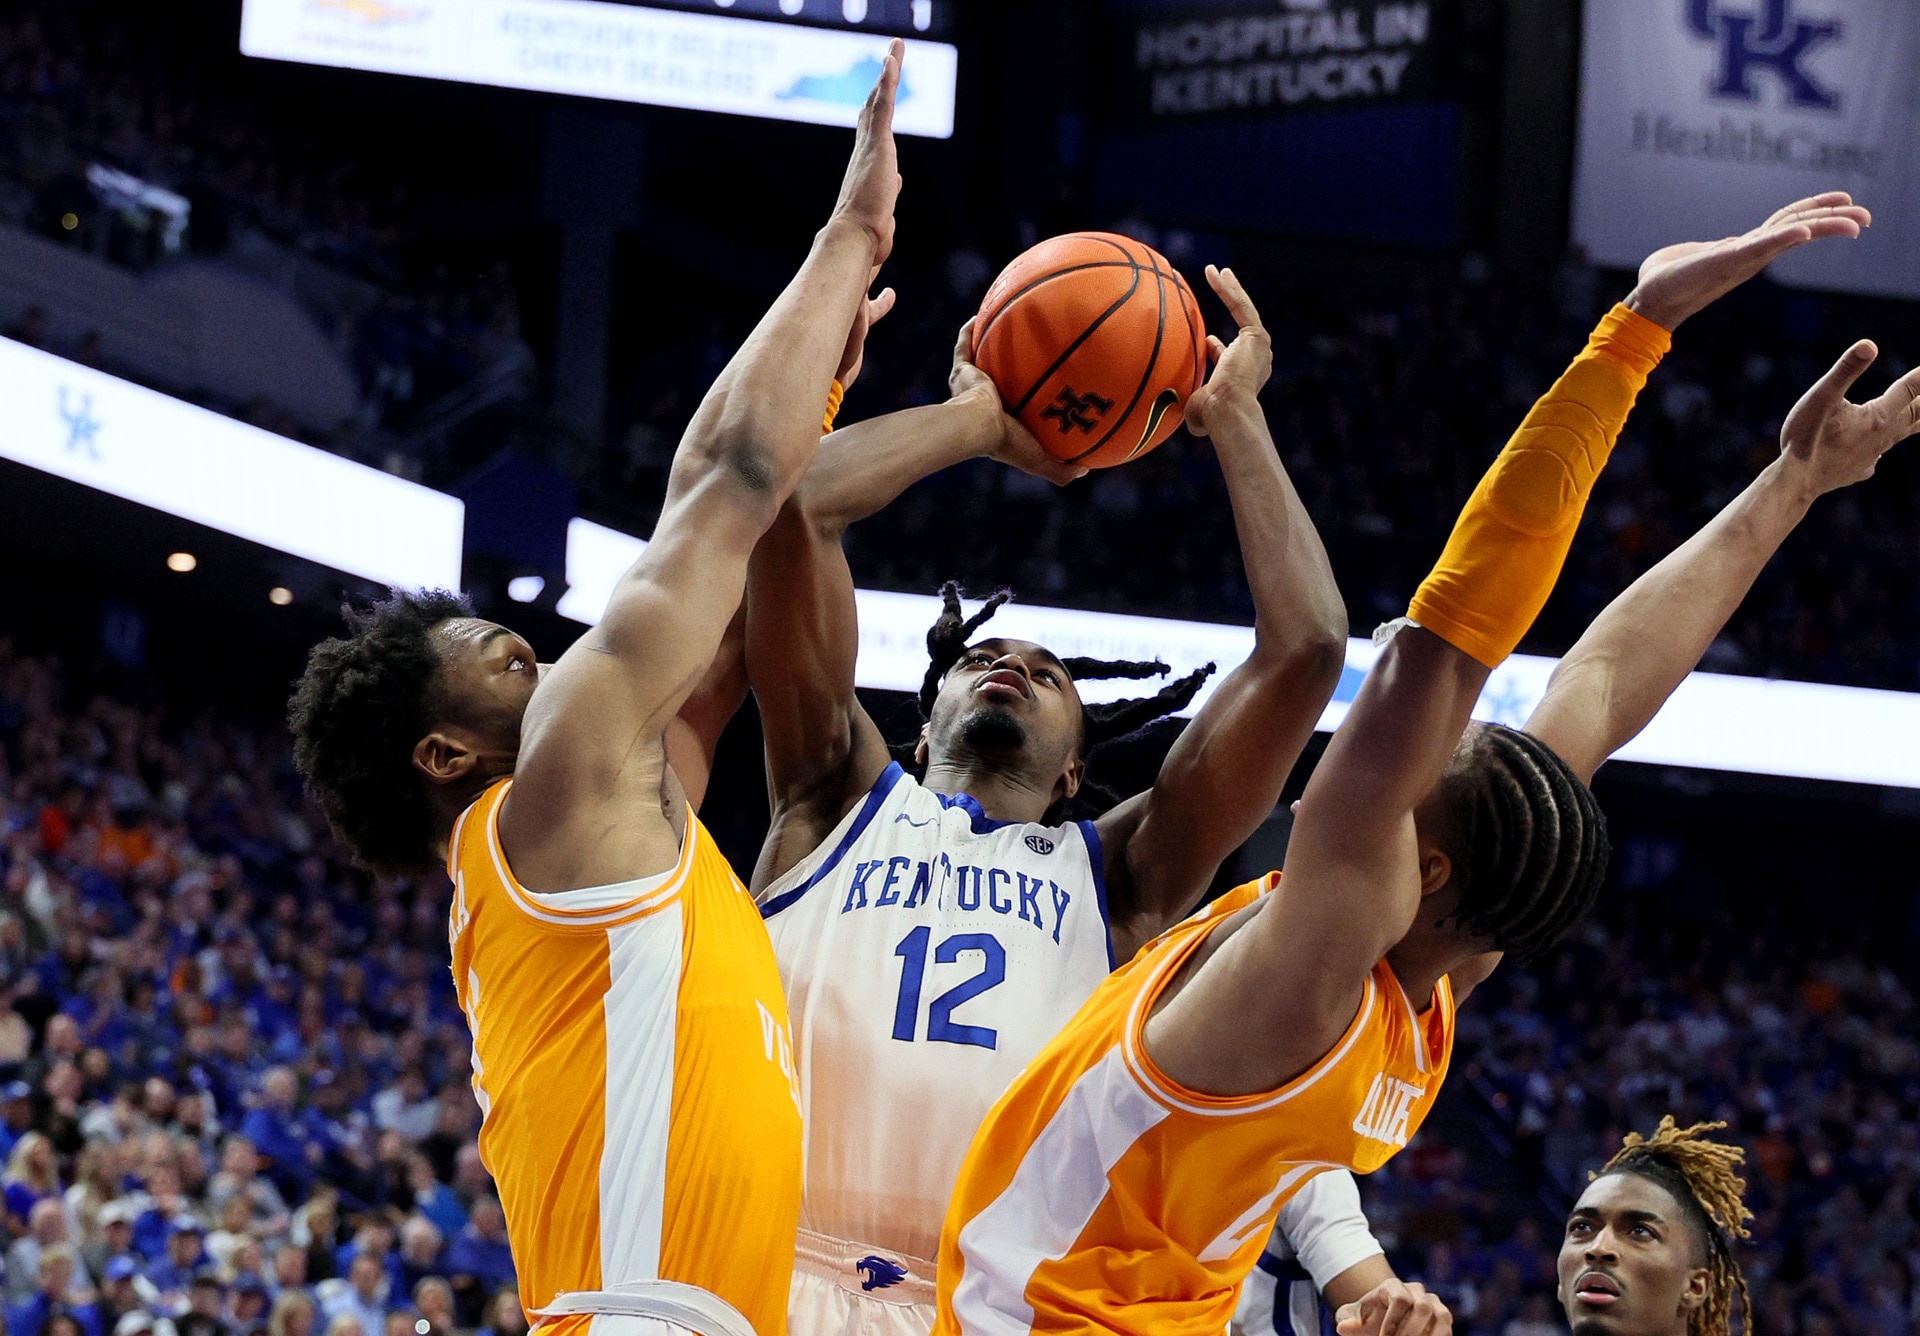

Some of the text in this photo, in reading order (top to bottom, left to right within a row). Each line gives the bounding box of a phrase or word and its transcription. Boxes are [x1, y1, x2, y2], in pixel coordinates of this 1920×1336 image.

[1135, 4, 1429, 68] HOSPITAL IN
[1152, 51, 1411, 114] KENTUCKY
[1631, 112, 1880, 177] HealthCare
[1026, 836, 1052, 854] SEC
[841, 851, 1071, 945] KENTUCKY
[892, 925, 1006, 1050] 12
